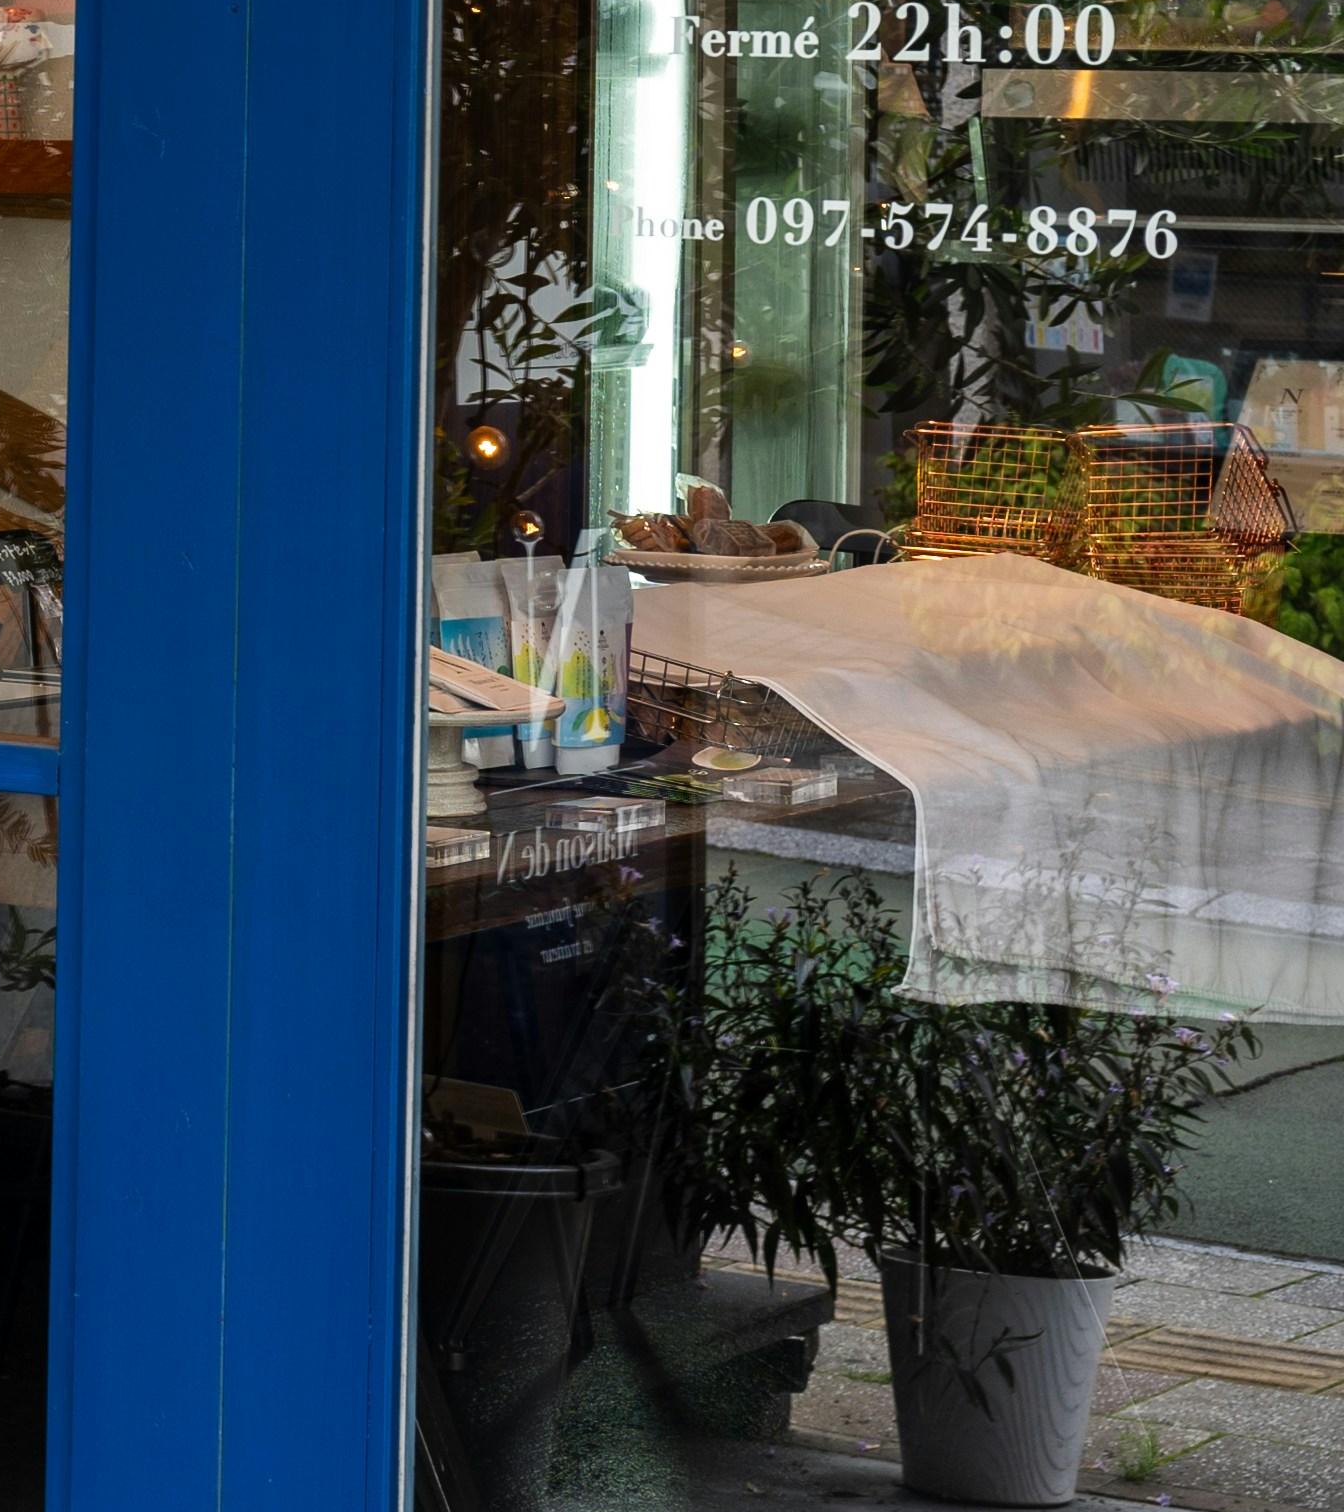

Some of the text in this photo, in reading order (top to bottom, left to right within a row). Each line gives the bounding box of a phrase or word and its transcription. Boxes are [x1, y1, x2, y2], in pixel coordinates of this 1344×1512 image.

[670, 1, 1118, 67] Fermé 22h:00
[744, 195, 1181, 262] 097-574-8876
[1279, 388, 1305, 405] N
